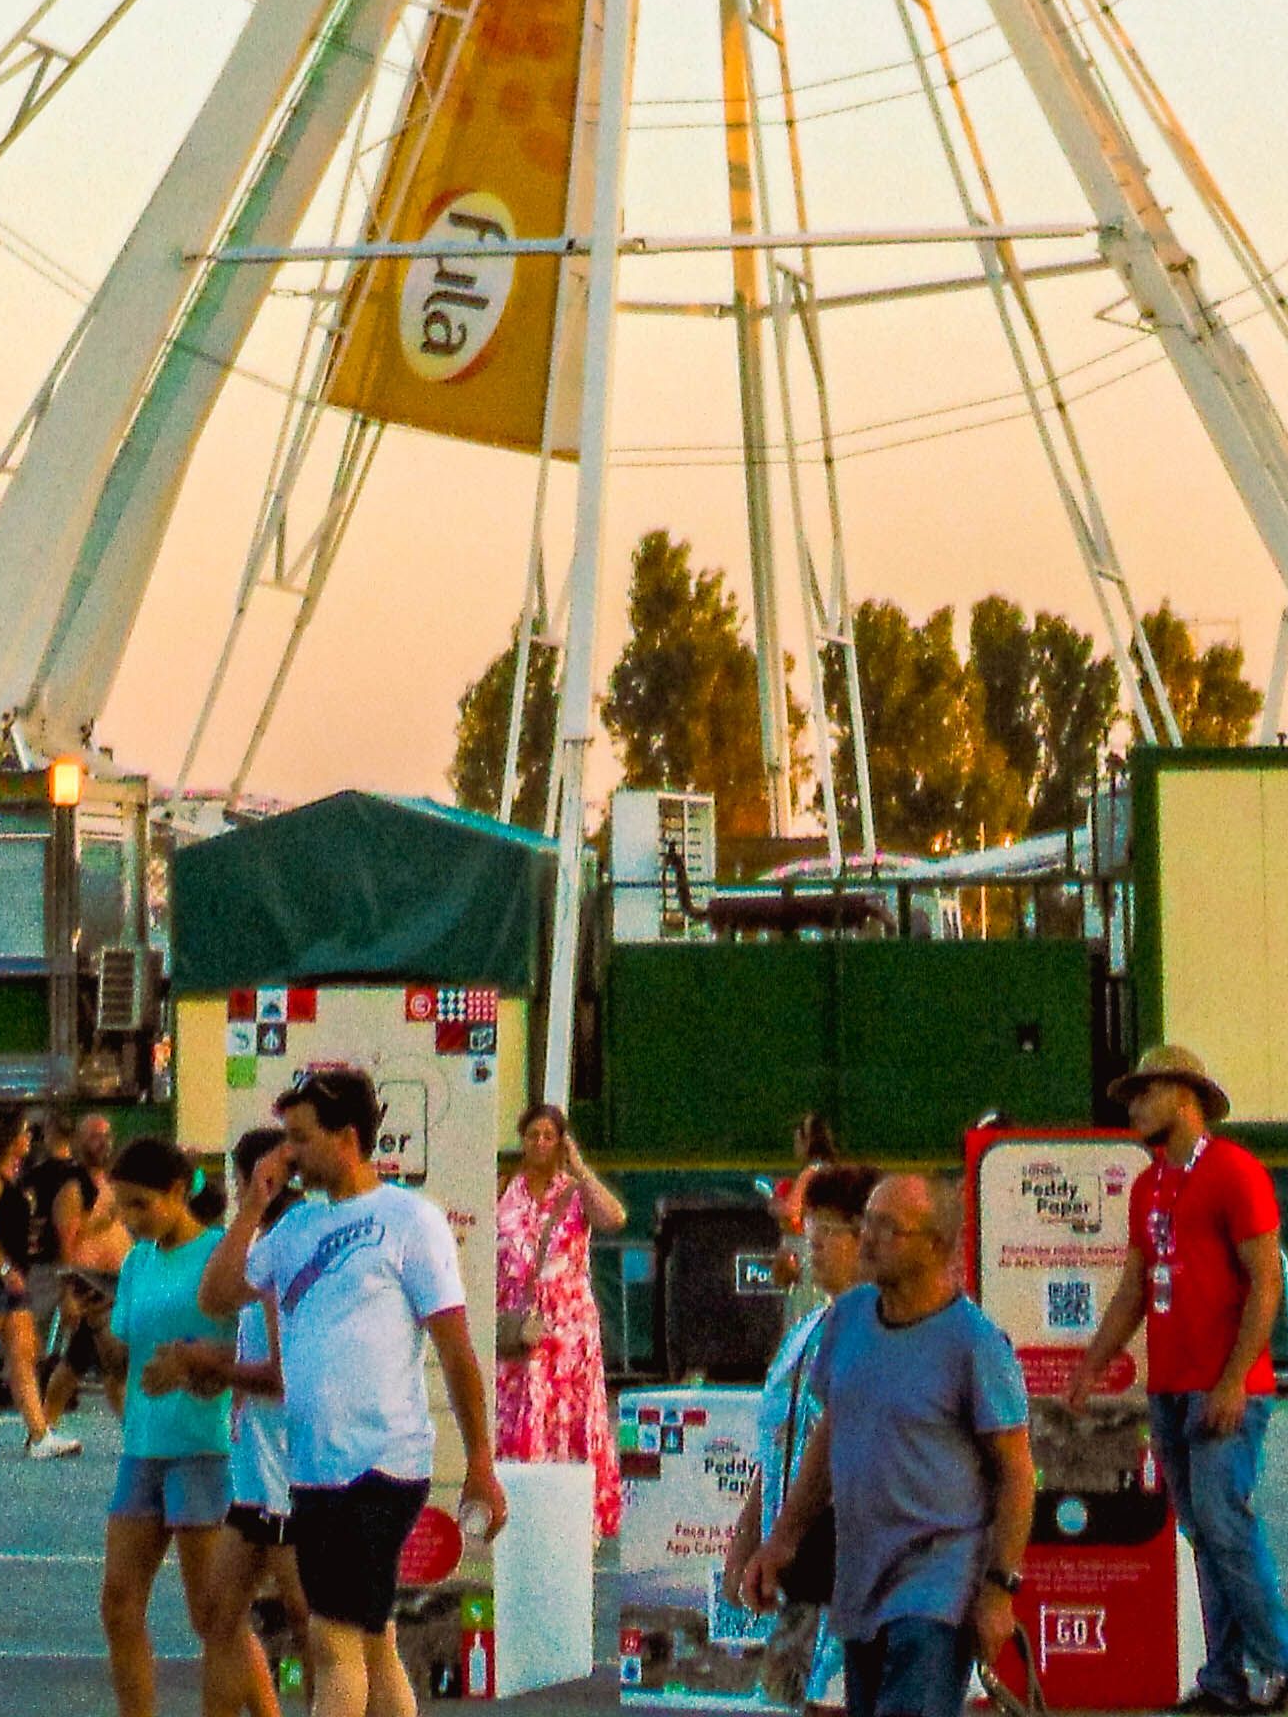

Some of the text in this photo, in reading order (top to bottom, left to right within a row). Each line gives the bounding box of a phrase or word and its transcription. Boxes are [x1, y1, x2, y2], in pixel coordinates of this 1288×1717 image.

[1021, 1179, 1079, 1200] Peddy
[1036, 1197, 1091, 1217] Paper
[704, 1457, 757, 1477] Peddy
[1055, 1618, 1089, 1646] GO
